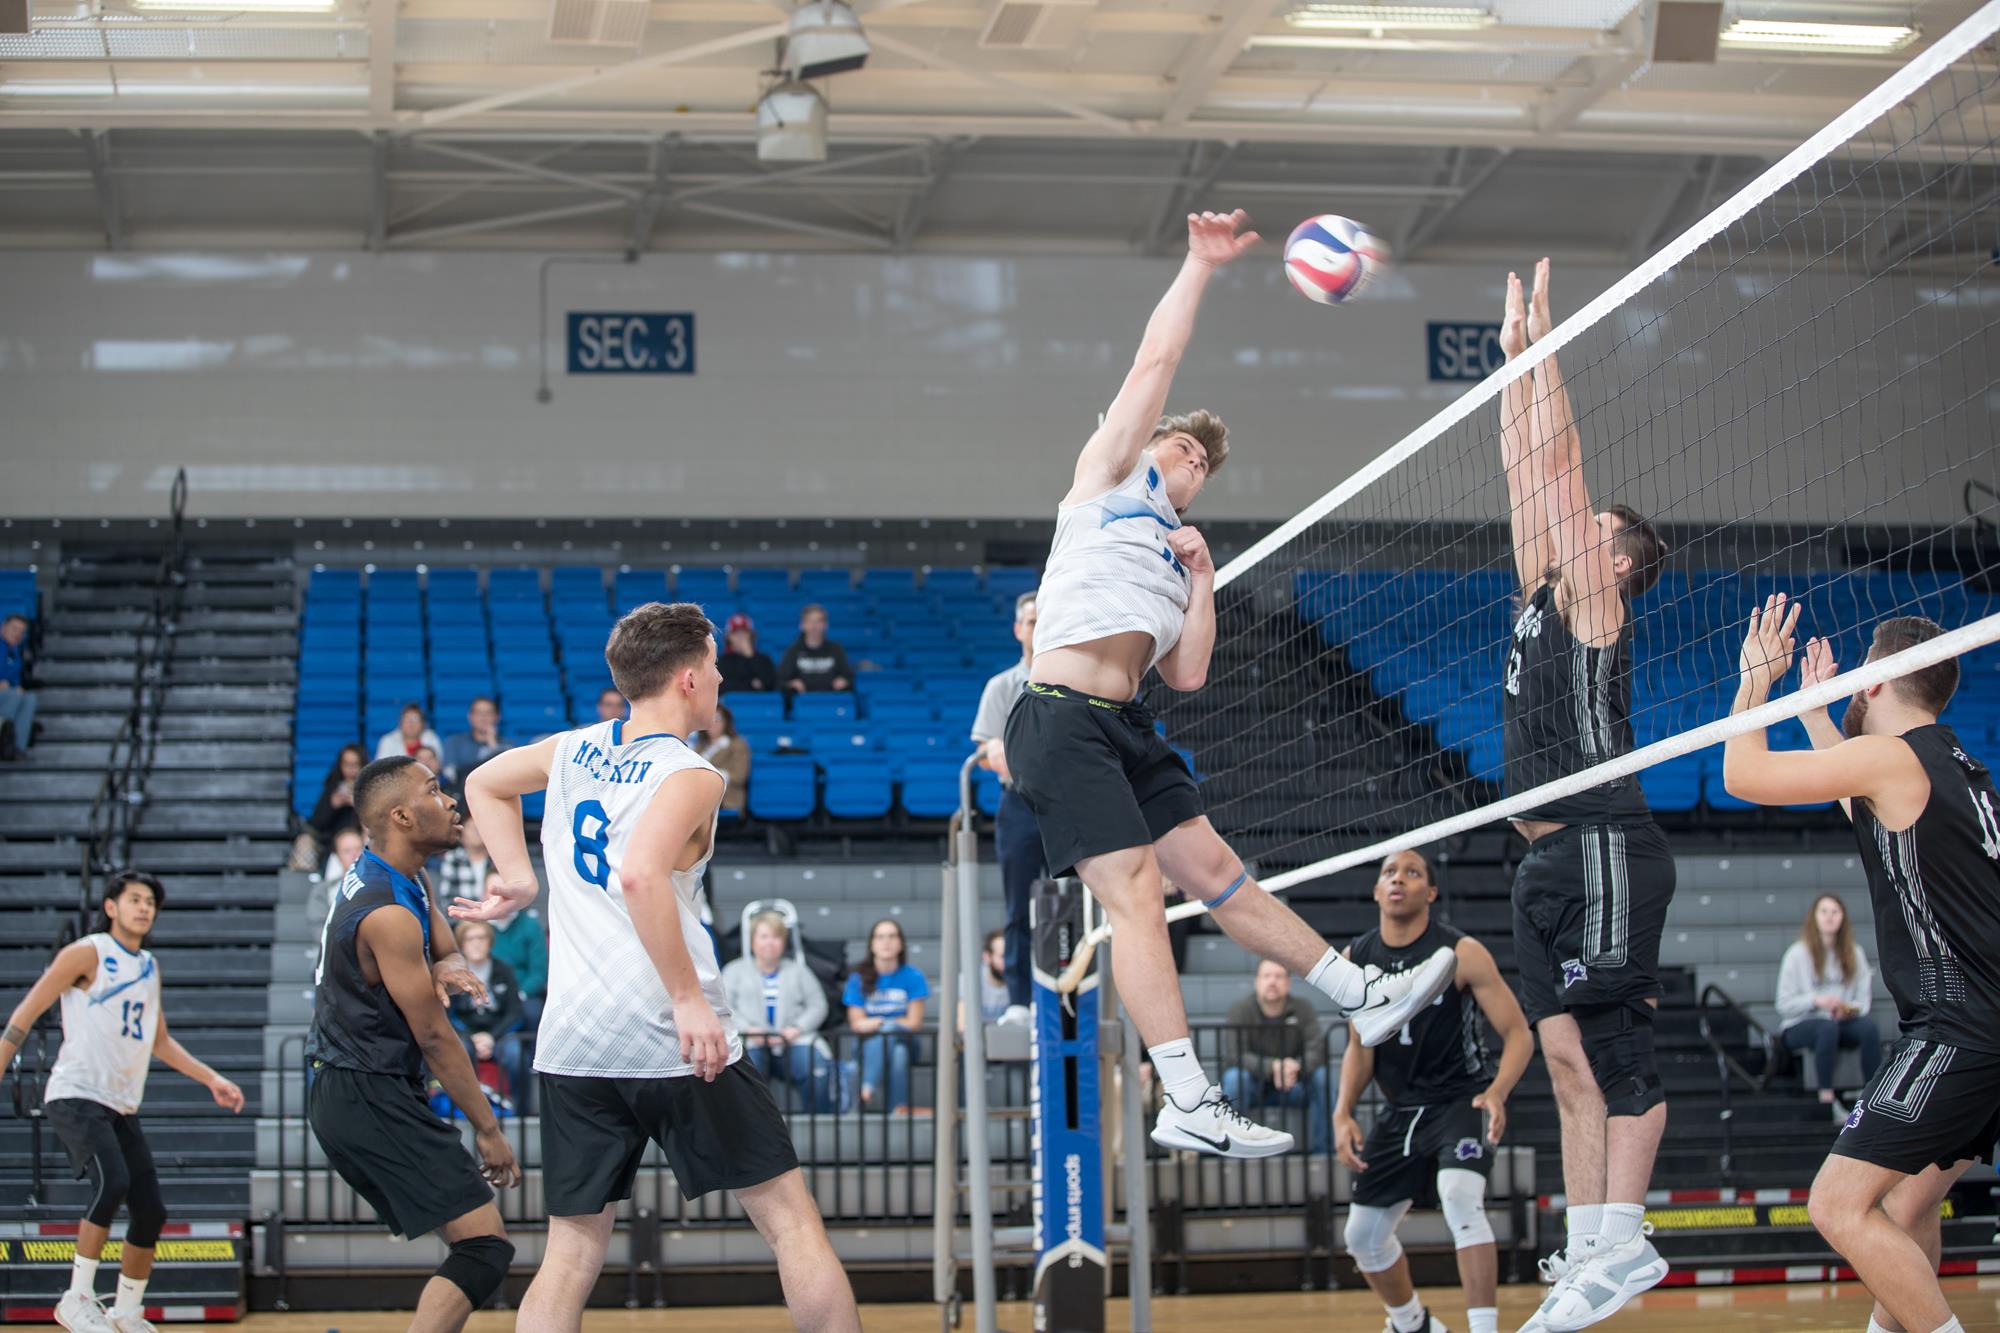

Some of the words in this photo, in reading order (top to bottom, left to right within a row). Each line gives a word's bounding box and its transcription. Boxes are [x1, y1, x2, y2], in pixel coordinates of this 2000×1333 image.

[578, 317, 658, 369] SEC.
[665, 317, 687, 369] 3
[573, 799, 611, 891] 8
[121, 1000, 144, 1040] 13
[1064, 1154, 1083, 1204] sports
[1064, 1206, 1083, 1269] impts
